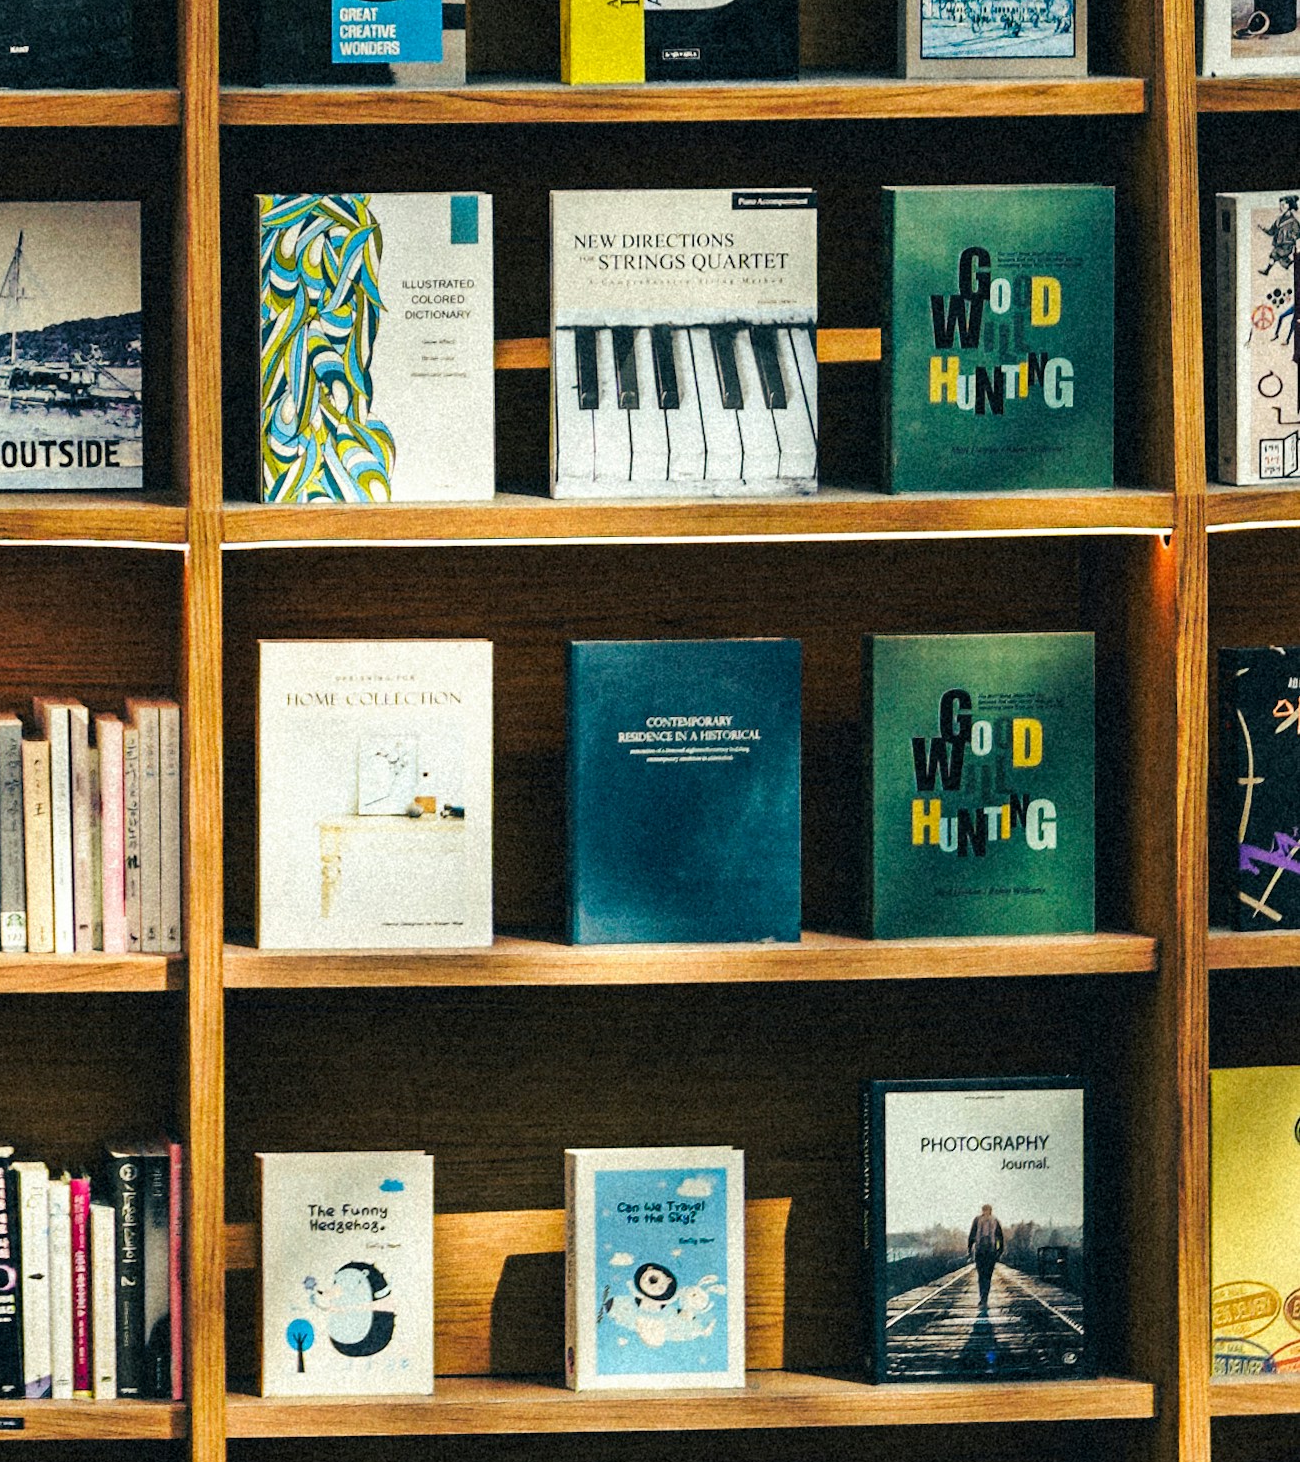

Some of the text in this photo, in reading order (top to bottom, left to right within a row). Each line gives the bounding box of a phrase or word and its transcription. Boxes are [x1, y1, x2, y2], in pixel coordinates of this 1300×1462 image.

[340, 8, 377, 22] GREAT
[340, 25, 395, 38] CREATIVE
[340, 41, 400, 55] WONDERS
[402, 279, 475, 290] ILLUSTRATED
[411, 294, 465, 305] COLORED
[404, 309, 471, 320] DICTIONARY
[2, 440, 120, 468] OUTSIDE
[921, 1135, 1049, 1152] PHOTOGRAPHY
[1002, 1157, 1049, 1170] Journal.
